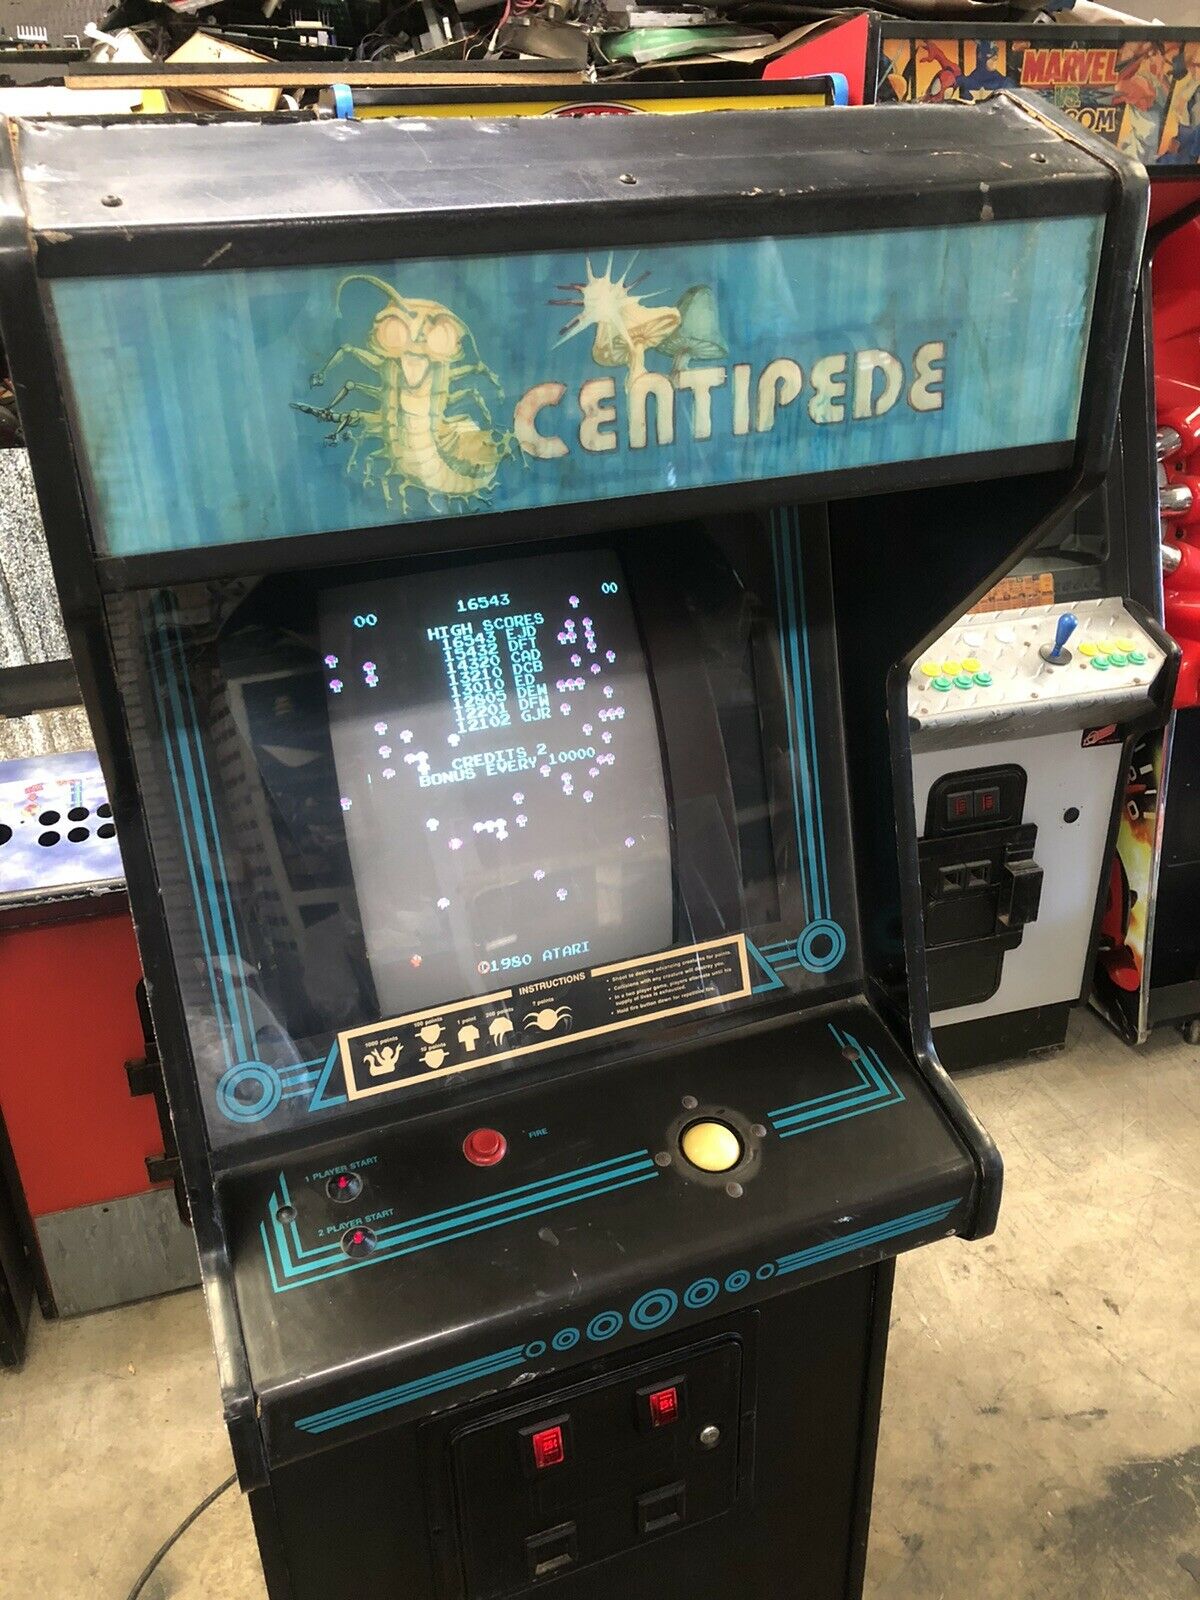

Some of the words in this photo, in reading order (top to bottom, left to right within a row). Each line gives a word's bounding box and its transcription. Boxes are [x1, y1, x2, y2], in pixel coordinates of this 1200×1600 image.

[1021, 49, 1118, 85] MARVEL
[512, 341, 946, 460] CENTIPEDE
[601, 582, 618, 594] 00
[457, 594, 510, 612] 16543
[353, 613, 378, 628] 00
[427, 622, 474, 641] HIGH
[482, 612, 545, 632] SCORES
[442, 631, 497, 651] 16543
[506, 626, 537, 640] EJD
[445, 643, 499, 662] 15432
[508, 637, 537, 652] DFT
[447, 654, 501, 674] 14320
[511, 648, 541, 663] CAD
[449, 666, 503, 686] 13210
[512, 660, 544, 675] DCB
[451, 678, 505, 698] 13010
[514, 673, 536, 687] ED
[453, 690, 507, 710] 12805
[455, 702, 509, 722] 12201
[458, 714, 512, 733] 12102
[521, 707, 552, 722] GJR
[419, 767, 476, 788] BONUS
[485, 756, 537, 777] EVERY
[548, 746, 596, 766] 10000
[452, 746, 527, 771] CREDITS
[536, 743, 548, 756] 2
[542, 941, 590, 962] ATARI
[518, 972, 586, 996] INSTRUCTIONS
[424, 1016, 443, 1026] points
[462, 1016, 477, 1025] point
[379, 1036, 399, 1046] points
[528, 1127, 549, 1139] FIRE
[304, 1175, 310, 1183] 1
[312, 1164, 348, 1181] PLAYER
[350, 1155, 379, 1172] START
[318, 1229, 325, 1238] 2
[326, 1217, 363, 1235] PLAYER
[364, 1208, 395, 1224] START
